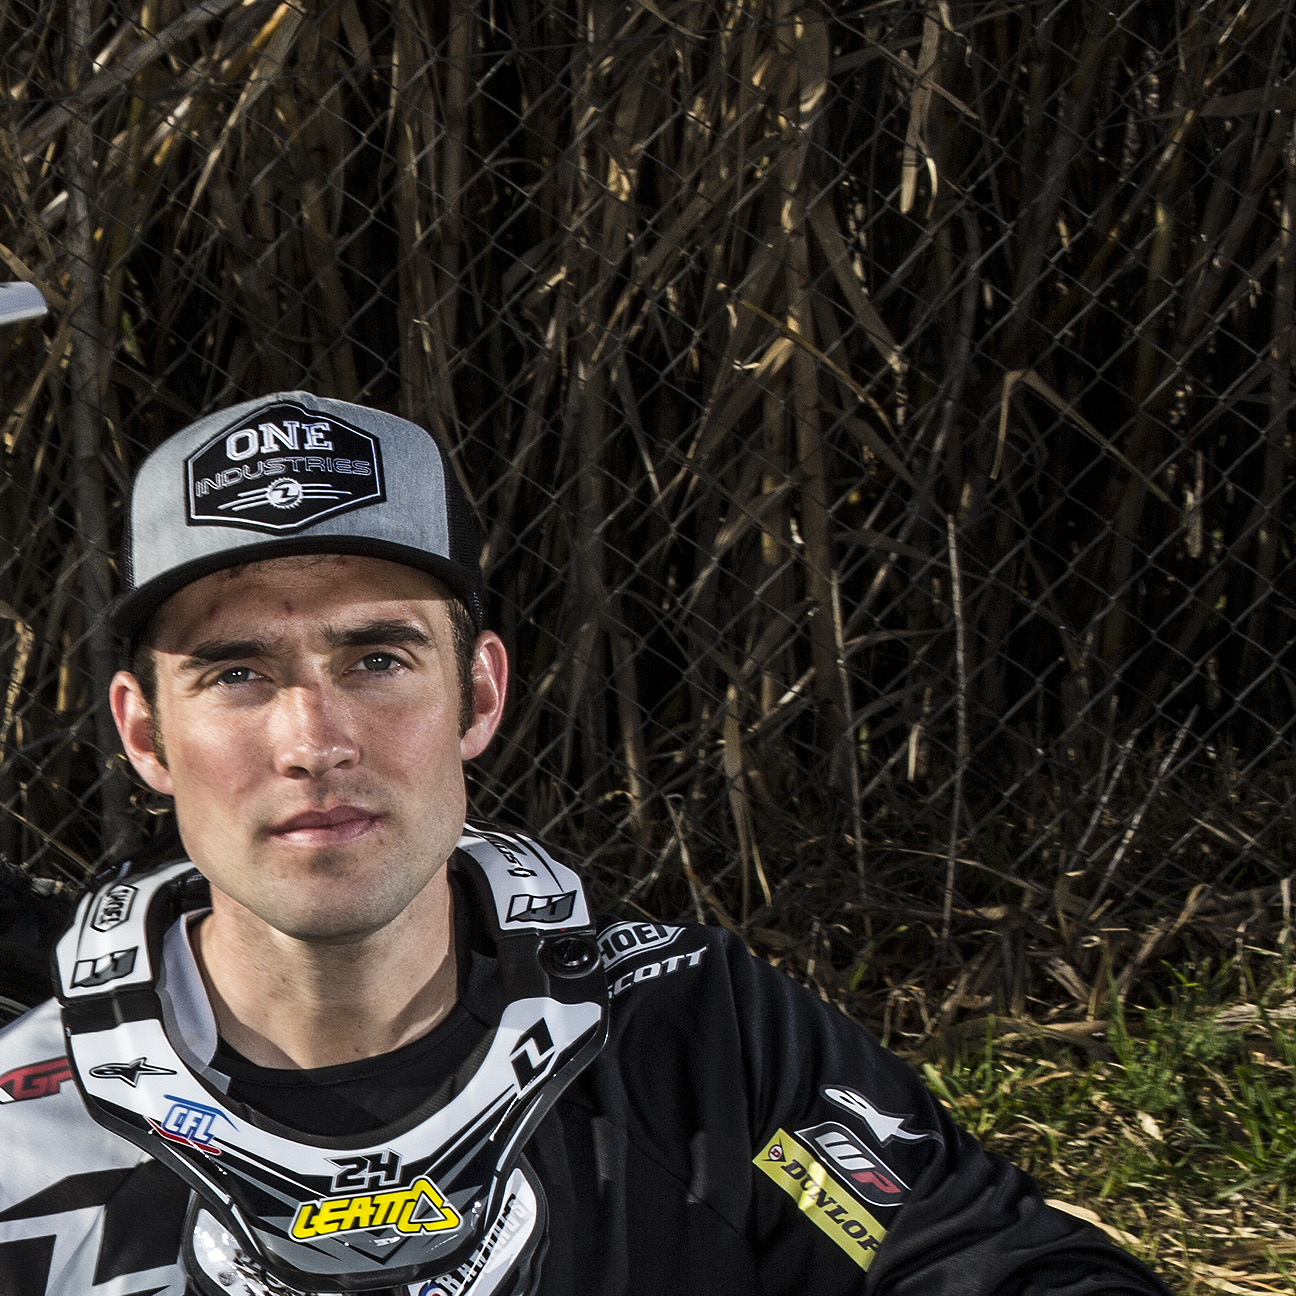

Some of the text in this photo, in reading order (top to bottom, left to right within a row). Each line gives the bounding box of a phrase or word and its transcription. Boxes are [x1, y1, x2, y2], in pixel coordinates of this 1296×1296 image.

[225, 420, 333, 461] ONE
[195, 456, 372, 497] INDUSTRIES
[167, 1106, 214, 1143] CFL
[330, 1149, 401, 1190] 24
[780, 1158, 881, 1252] DUNLOP
